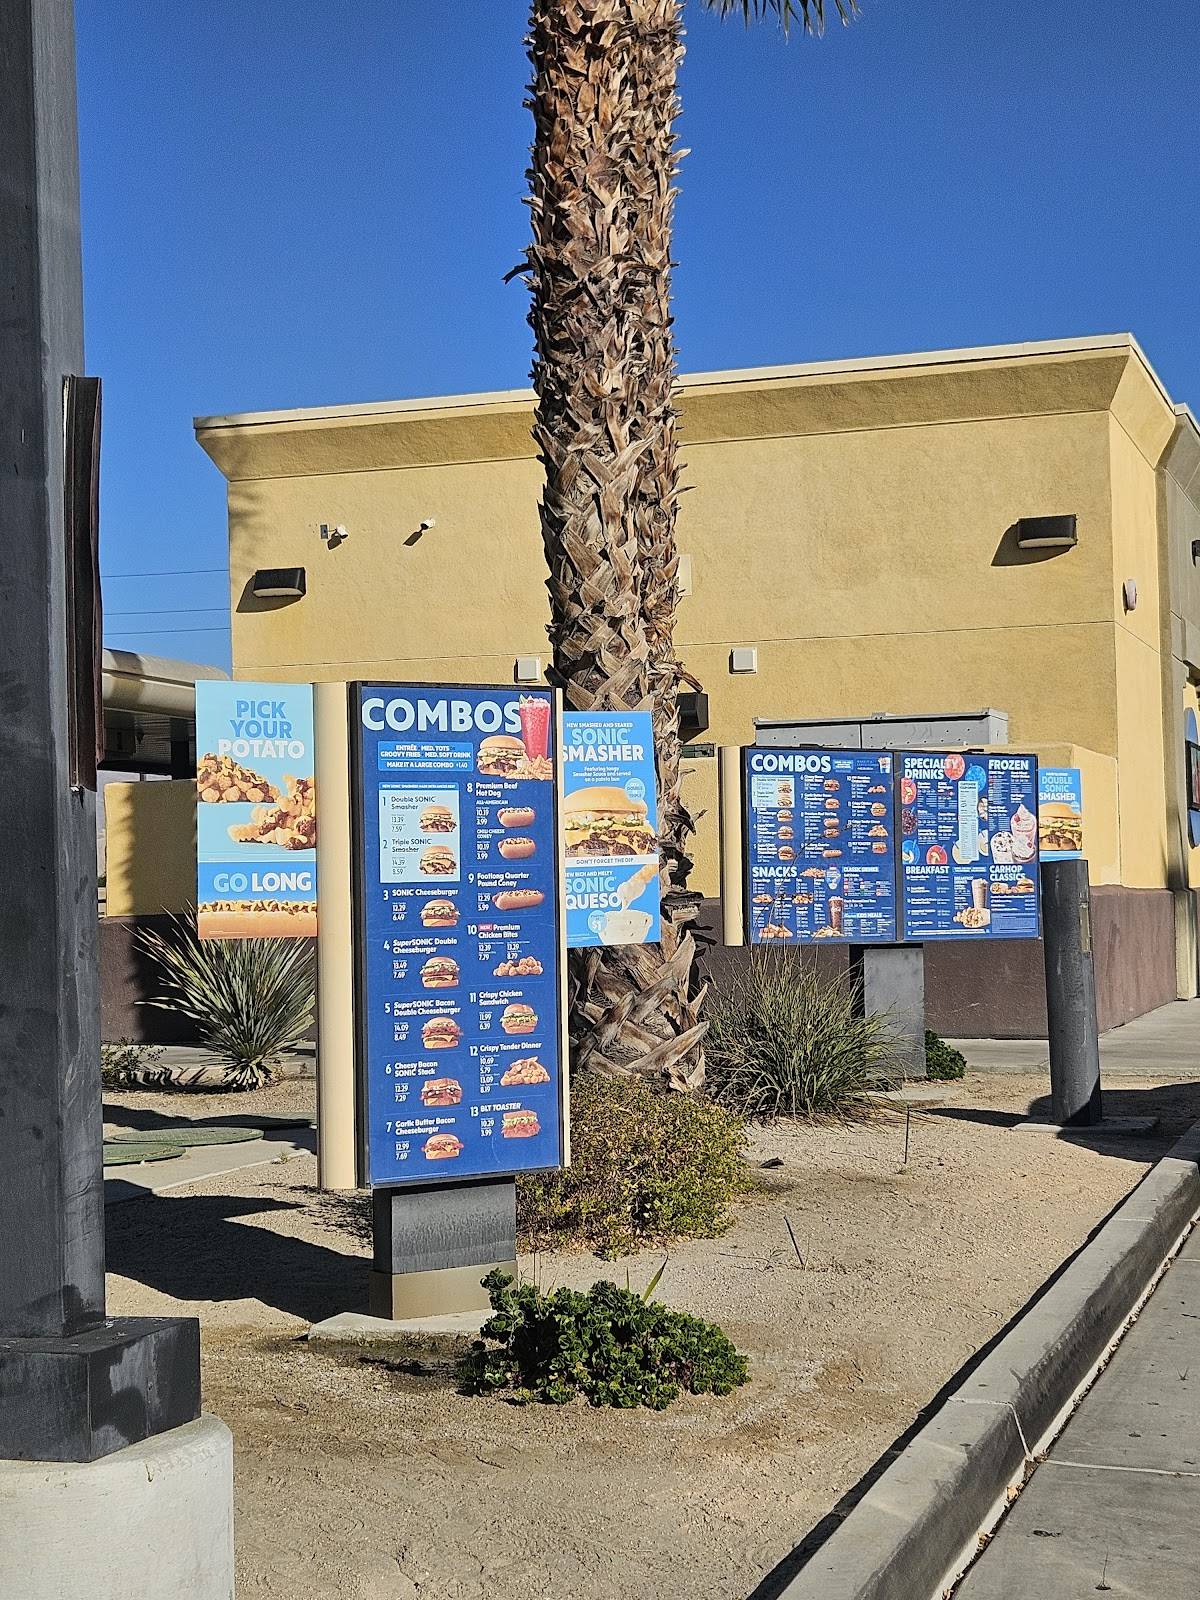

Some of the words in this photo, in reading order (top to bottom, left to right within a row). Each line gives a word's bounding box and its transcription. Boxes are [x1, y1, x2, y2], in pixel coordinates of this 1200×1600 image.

[236, 700, 286, 719] PICK
[362, 698, 522, 732] COMBOS
[230, 720, 292, 738] YOUR
[572, 728, 629, 745] SONIC
[218, 739, 305, 759] POTATO
[562, 745, 644, 762] SMASHER
[751, 754, 831, 772] COMBOS
[904, 758, 959, 769] SPECIALTY
[989, 760, 1029, 770] FROZEN
[905, 769, 944, 780] DRINKS
[467, 782, 472, 792] 8
[383, 840, 388, 848] 2
[752, 867, 797, 878] SNACKS
[906, 866, 950, 874] BREAKFAST
[990, 865, 1022, 873] CARHOP
[213, 873, 248, 893] GO
[252, 872, 312, 892] LONG
[468, 873, 474, 883] 9
[990, 873, 1026, 881] CLASSICS
[566, 876, 615, 893] SONIC
[383, 890, 389, 900] 3
[566, 892, 622, 909] QUESO
[467, 925, 477, 935] 10
[383, 941, 390, 950] 4
[470, 993, 476, 1002] 11
[385, 1003, 390, 1013] 5
[394, 1000, 434, 1009] SuperSONIC
[470, 1046, 478, 1056] 12
[386, 1064, 392, 1074] 6
[470, 1106, 478, 1117] 13
[493, 1102, 521, 1111] TOASTER
[386, 1122, 392, 1132] 7
[396, 1120, 414, 1128] Garlic
[396, 1126, 439, 1135] Cheeseburger
